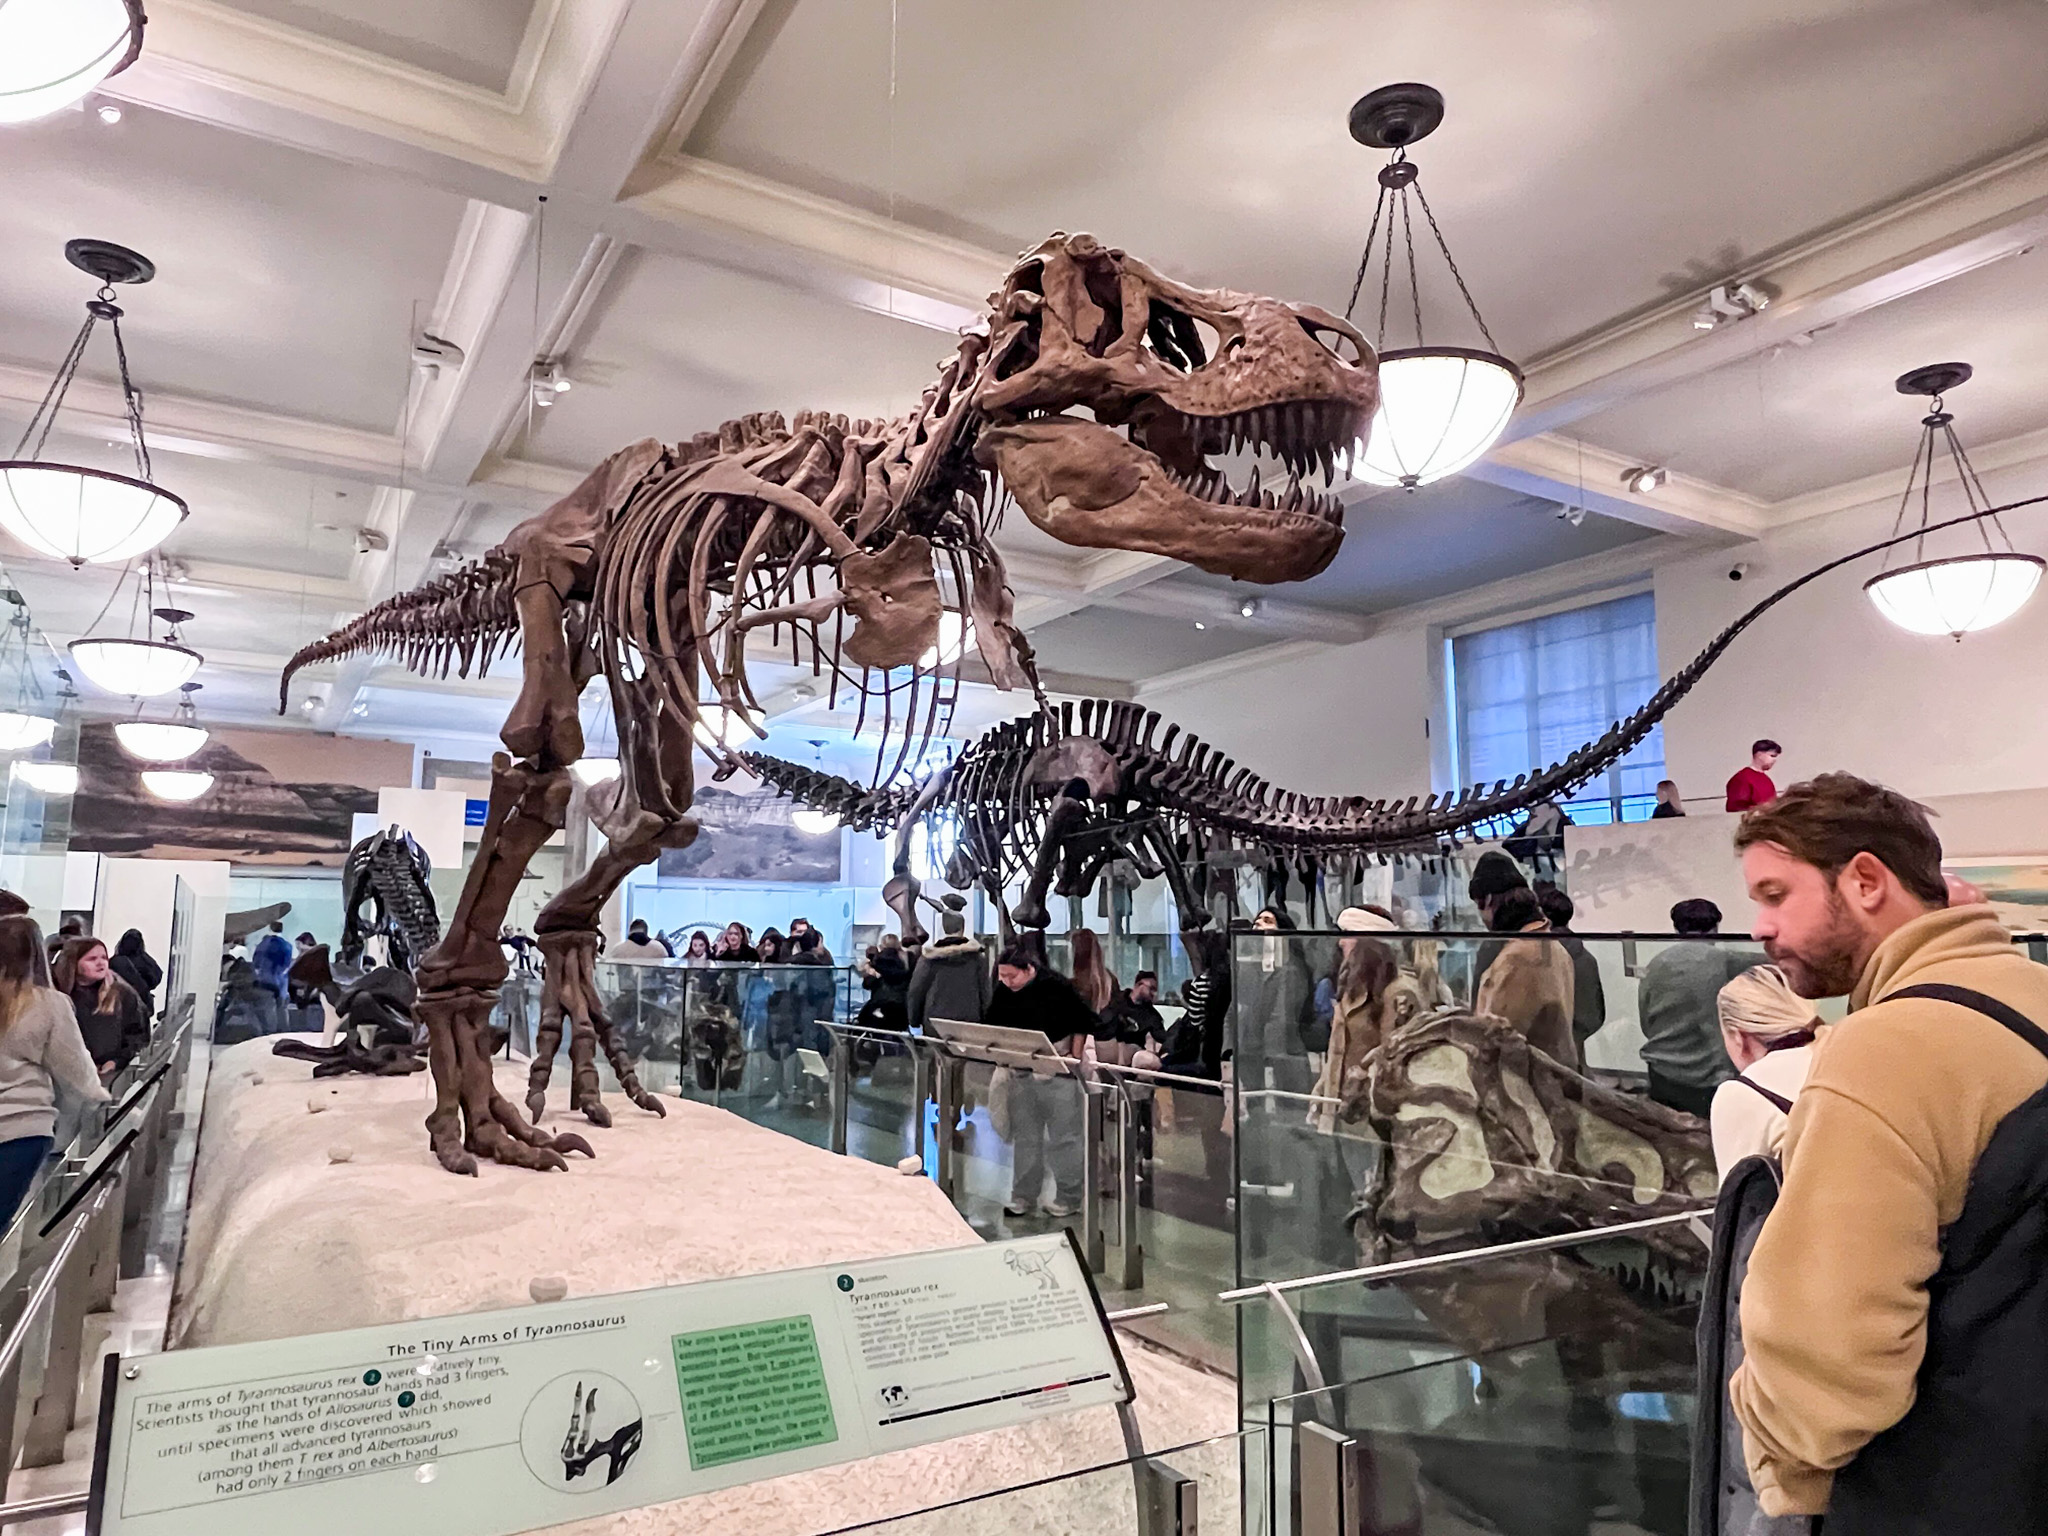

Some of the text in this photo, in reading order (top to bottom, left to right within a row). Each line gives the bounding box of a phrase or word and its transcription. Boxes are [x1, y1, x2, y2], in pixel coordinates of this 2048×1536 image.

[849, 1283, 939, 1303] Tyrannosaurus rex
[387, 1316, 625, 1356] The Tiny Arms of Tyrannosaurus
[137, 1413, 203, 1431] Scientists
[209, 1403, 265, 1418] thought
[271, 1399, 297, 1411] that
[303, 1385, 380, 1406] tyrannosaur
[385, 1378, 423, 1392] hands
[425, 1373, 449, 1386] had
[455, 1372, 461, 1382] 3
[148, 1403, 172, 1414] The
[177, 1398, 212, 1410] arms
[216, 1392, 231, 1404] of
[239, 1381, 332, 1402] Tyrannosaurus
[338, 1377, 356, 1386] rex
[387, 1367, 417, 1379] were
[159, 1394, 491, 1457] until specimens were discovered which showed
[217, 1424, 231, 1433] as
[237, 1418, 258, 1430] the
[264, 1411, 303, 1425] hands
[308, 1406, 321, 1419] of
[326, 1398, 392, 1416] Allosaurus
[198, 1465, 252, 1483] (among
[259, 1458, 293, 1472] them
[313, 1452, 333, 1462] rex
[338, 1443, 362, 1458] and
[367, 1428, 457, 1453] Albertosaurus)
[231, 1422, 431, 1461] that all advanced tyrannosaurs
[216, 1479, 245, 1494] had
[247, 1475, 278, 1489] only
[284, 1471, 291, 1483] 2
[297, 1464, 343, 1482] fingers
[348, 1460, 365, 1473] on
[371, 1452, 401, 1467] each
